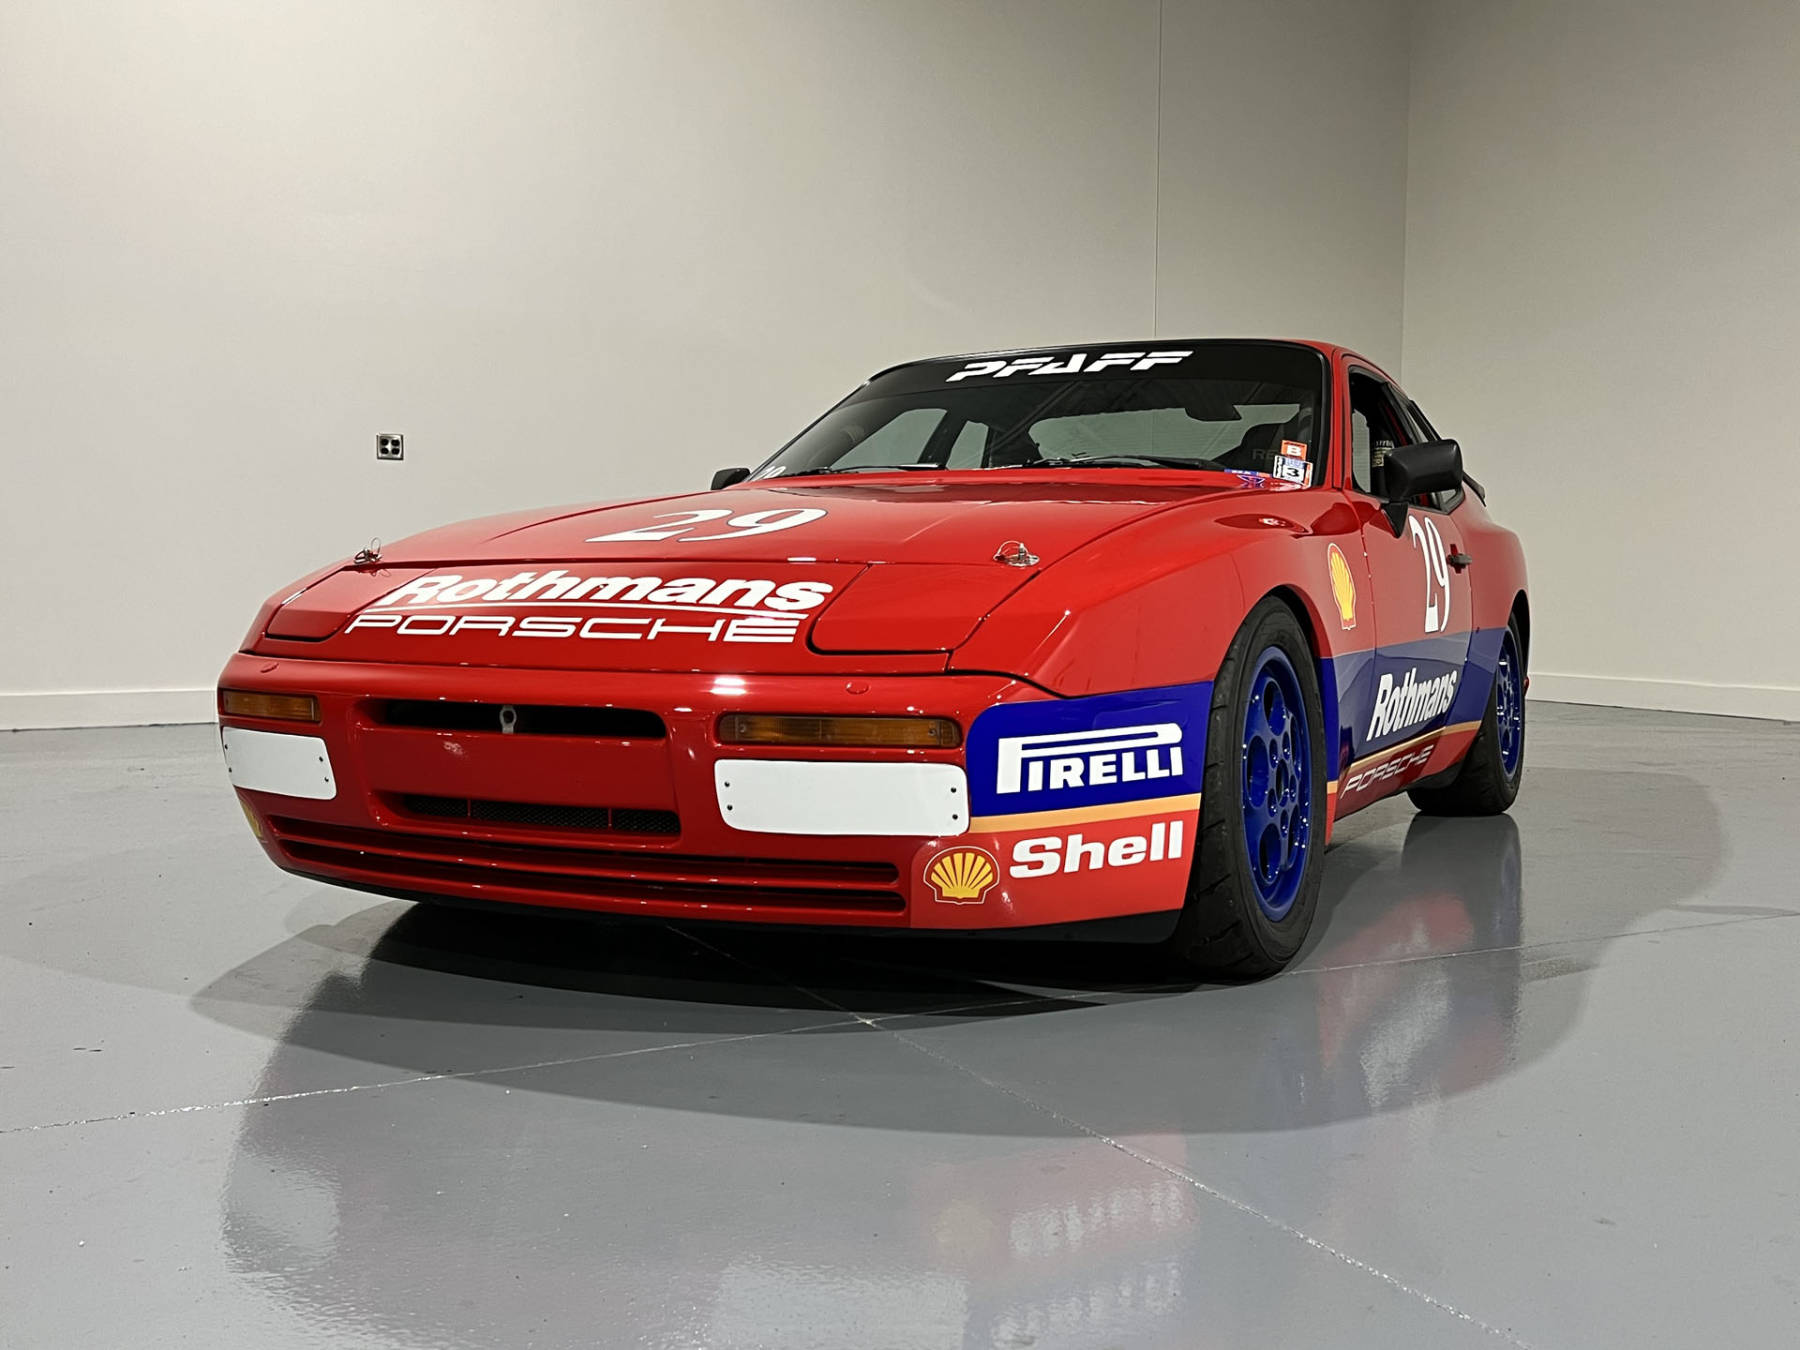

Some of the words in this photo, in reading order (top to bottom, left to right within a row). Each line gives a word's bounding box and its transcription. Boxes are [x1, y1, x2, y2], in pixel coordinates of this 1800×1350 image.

[945, 350, 1194, 383] PFAFF
[585, 508, 827, 543] 29
[374, 569, 834, 612] Rothmans
[1408, 514, 1450, 633] 29
[344, 614, 801, 644] PORSCHE
[1365, 667, 1458, 742] Rothmans
[996, 722, 1183, 794] PIRELLI
[1340, 744, 1435, 799] PORSCHE
[1009, 820, 1184, 879] Shell
